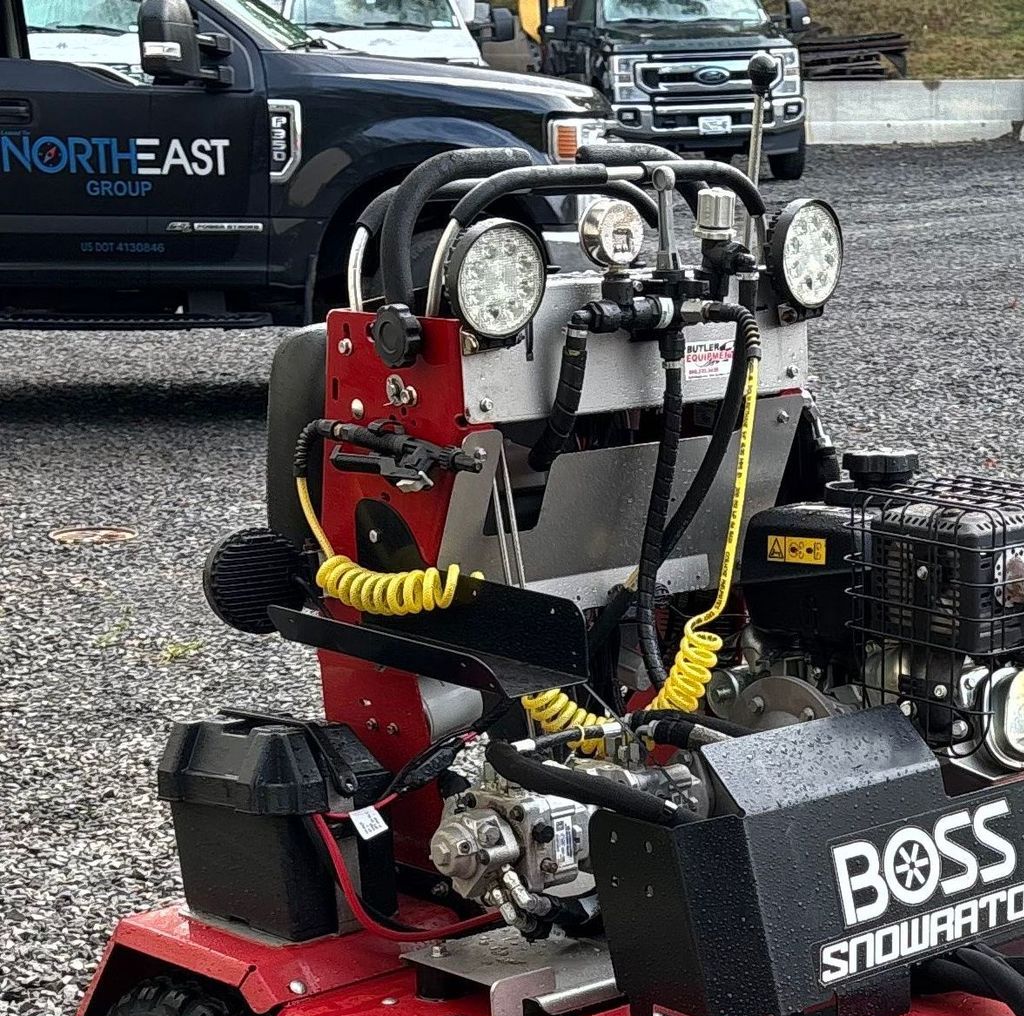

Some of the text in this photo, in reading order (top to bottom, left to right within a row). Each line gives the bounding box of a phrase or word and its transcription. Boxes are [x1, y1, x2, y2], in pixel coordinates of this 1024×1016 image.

[271, 116, 287, 162] F350
[1, 136, 230, 176] NORTHEAST
[86, 180, 152, 197] GROUP
[80, 242, 94, 252] US
[95, 242, 114, 252] DOT
[687, 342, 720, 354] BUTLER
[833, 800, 1016, 926] BOSS
